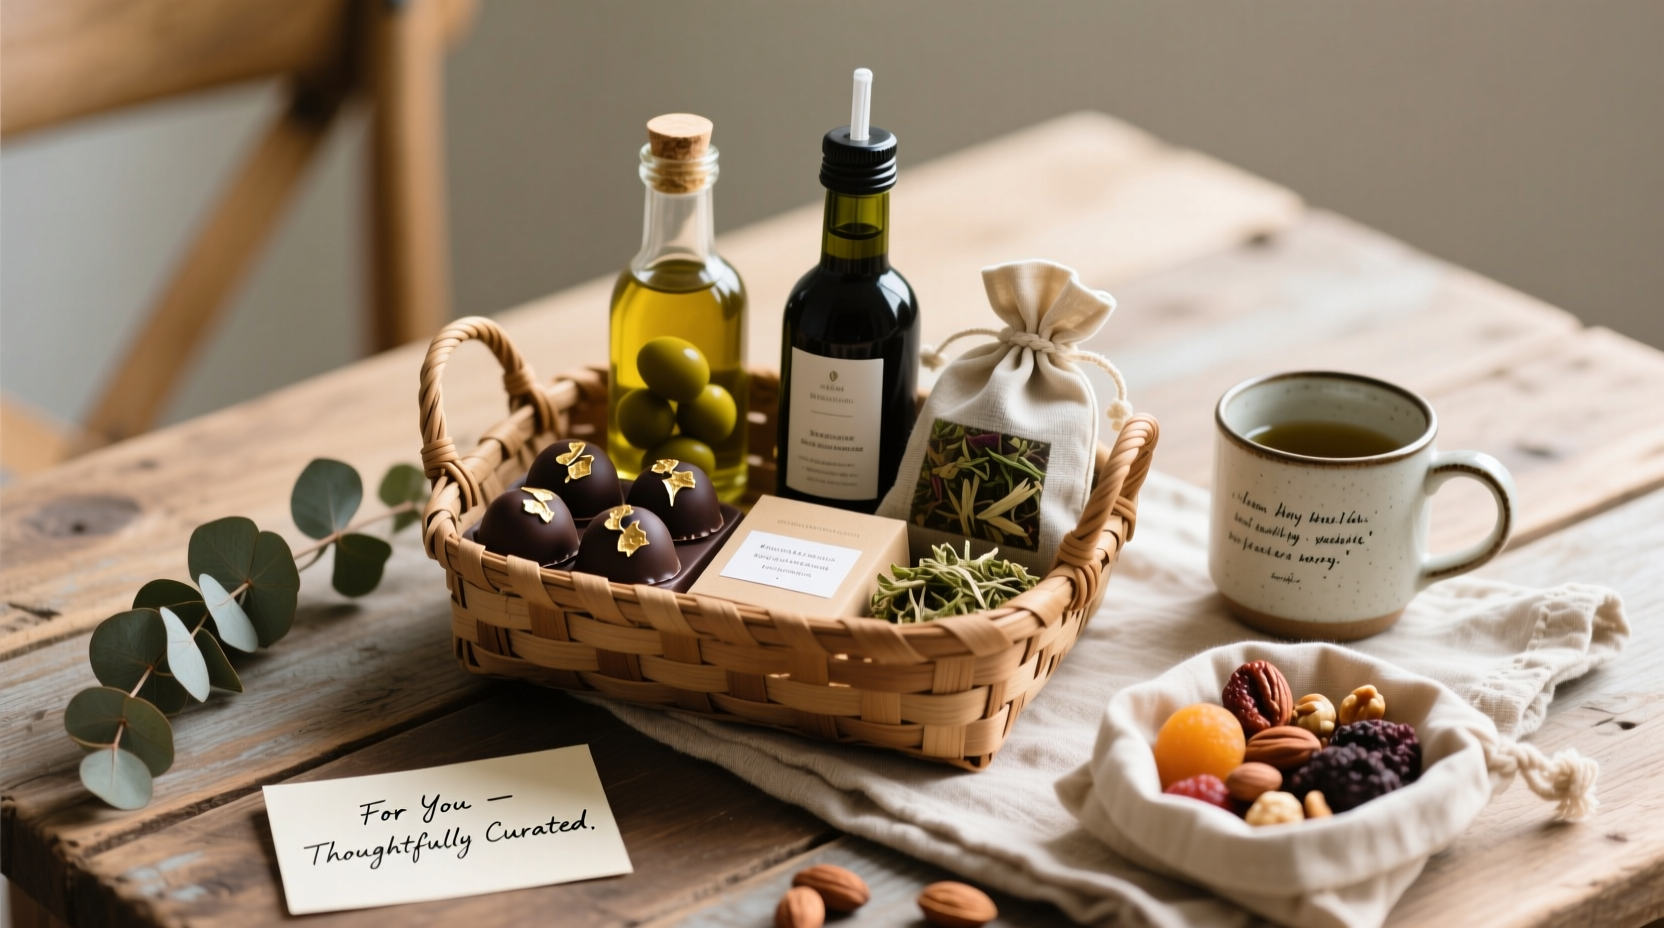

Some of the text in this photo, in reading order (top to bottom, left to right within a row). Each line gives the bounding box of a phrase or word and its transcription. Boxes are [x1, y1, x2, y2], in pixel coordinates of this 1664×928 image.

[359, 799, 408, 826] For
[421, 794, 473, 824] You
[303, 808, 597, 870] Thoughtfully Curated.
